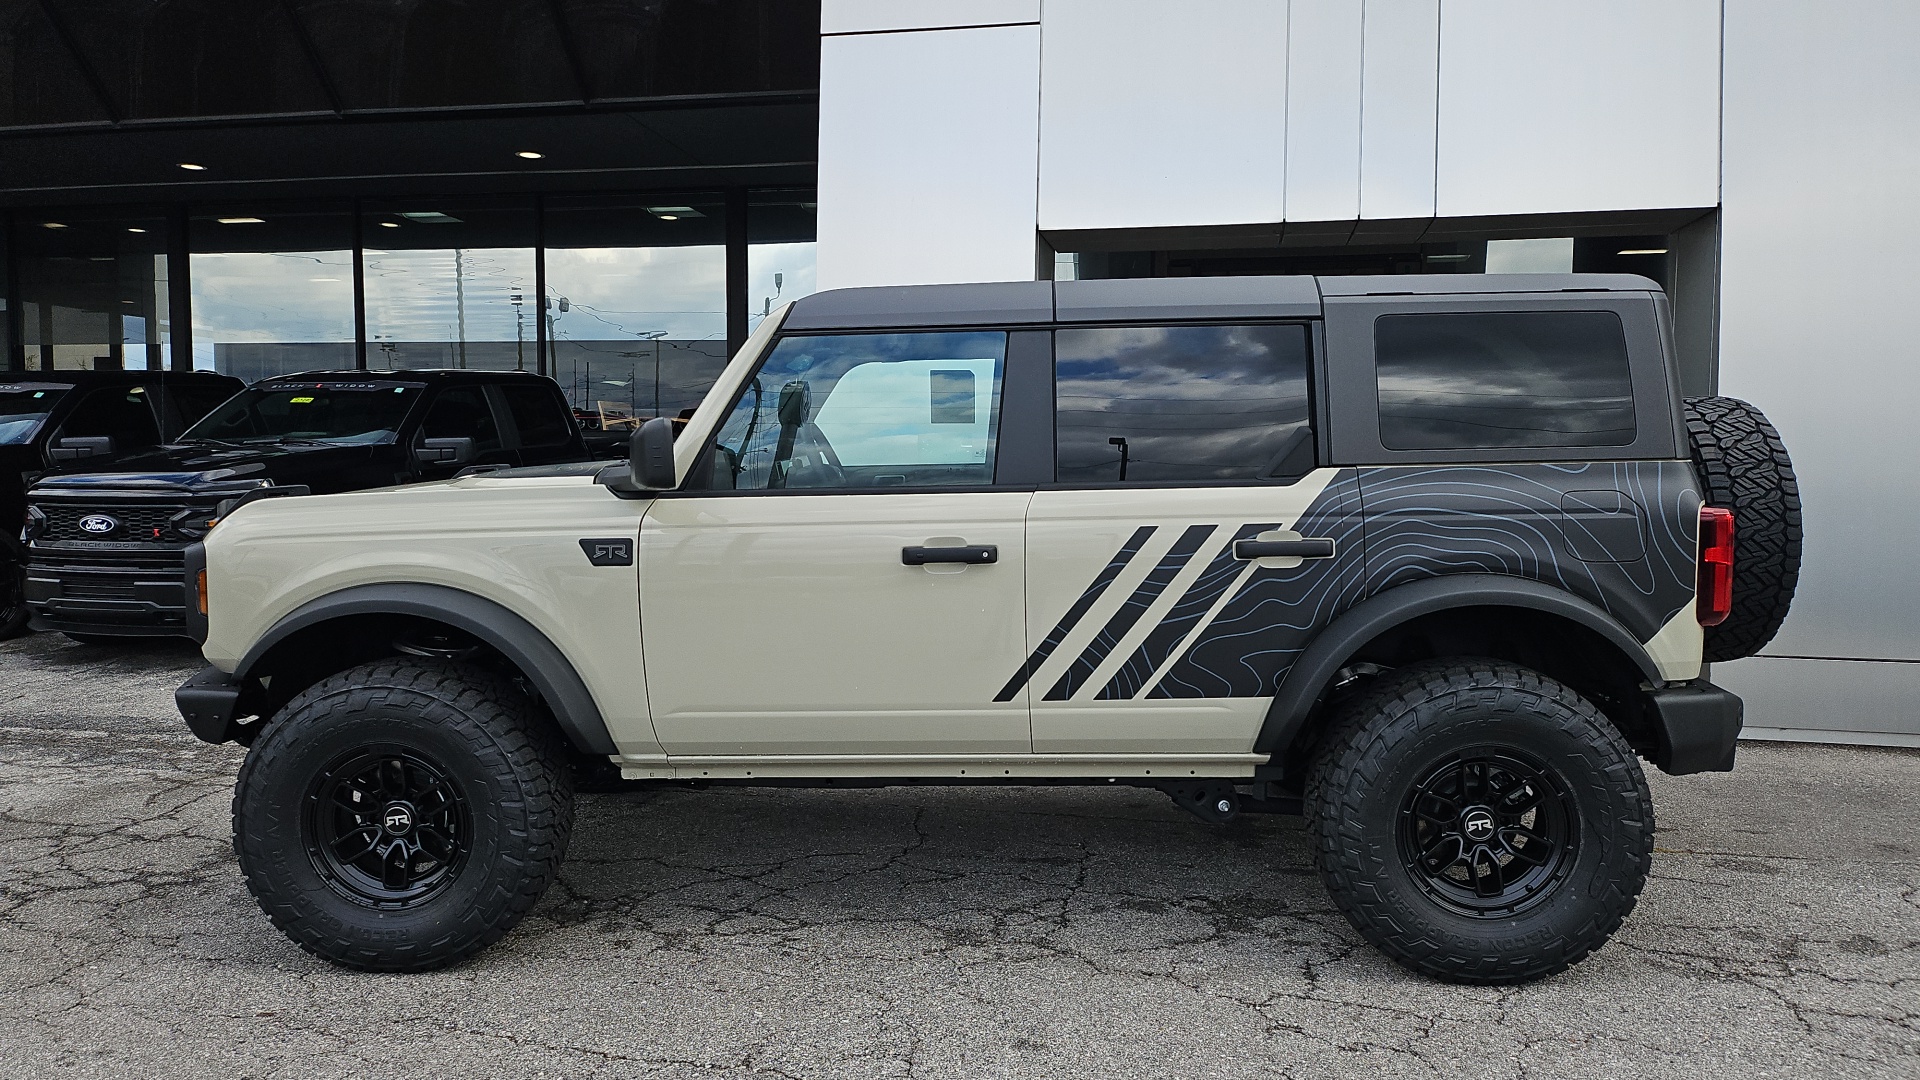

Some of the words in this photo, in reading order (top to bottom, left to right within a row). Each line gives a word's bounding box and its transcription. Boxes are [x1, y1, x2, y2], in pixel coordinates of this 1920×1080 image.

[85, 519, 107, 530] Ford
[593, 544, 628, 559] RTR
[1489, 926, 1555, 952] RECON
